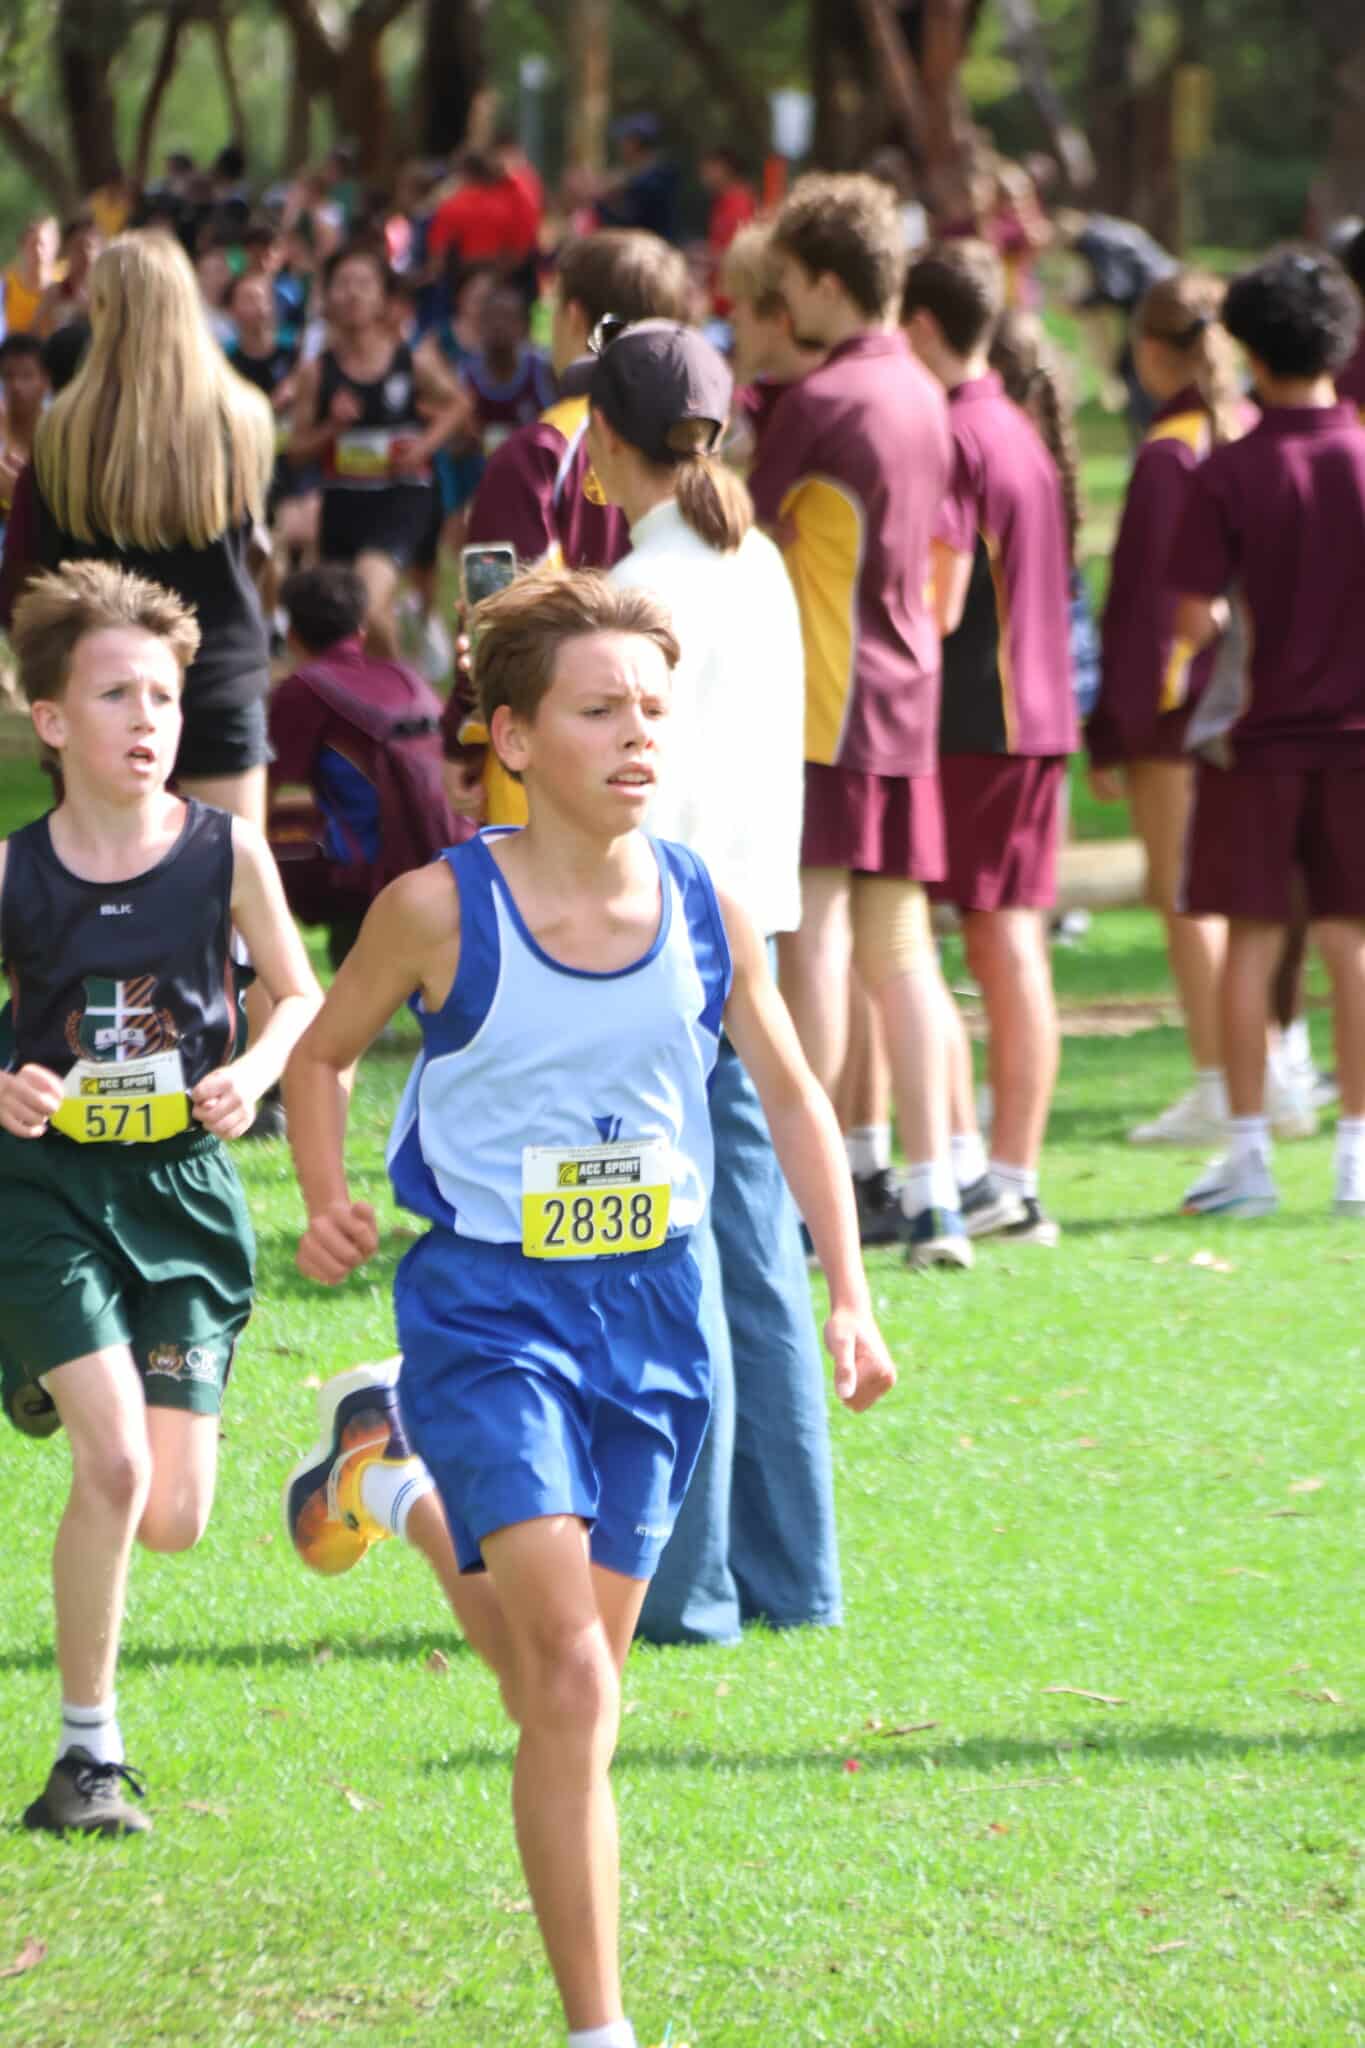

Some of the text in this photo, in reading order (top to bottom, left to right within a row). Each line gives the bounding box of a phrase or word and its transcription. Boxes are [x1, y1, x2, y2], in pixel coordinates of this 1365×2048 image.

[100, 904, 134, 916] BLK
[86, 1103, 151, 1137] 571
[579, 1159, 639, 1176] ACC SPORT
[544, 1194, 652, 1246] 2838
